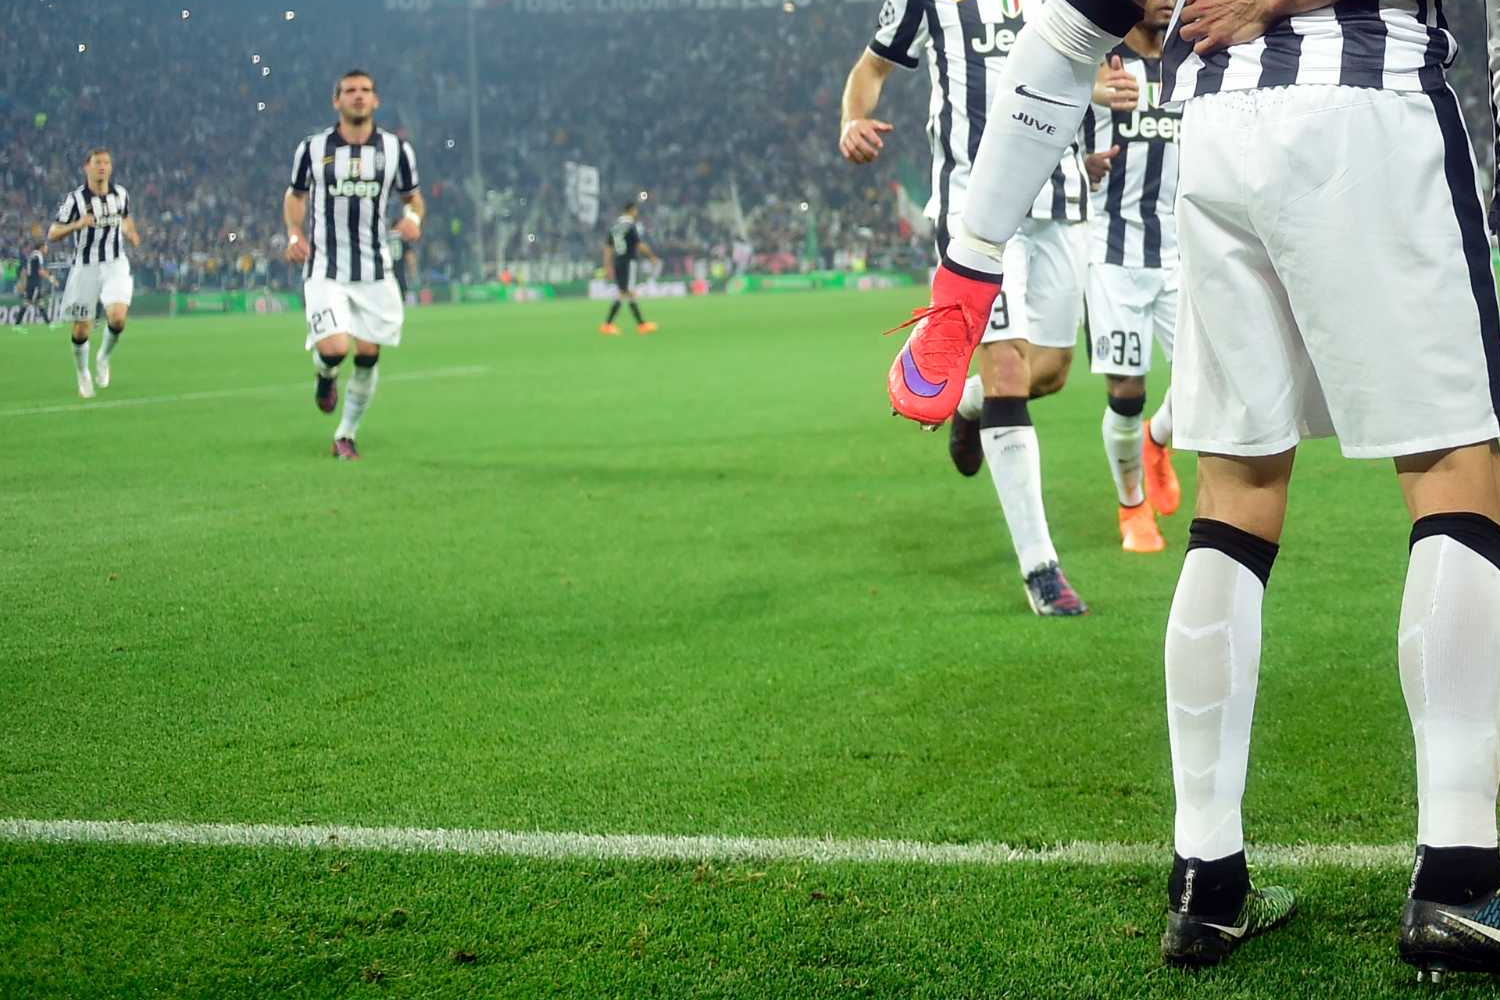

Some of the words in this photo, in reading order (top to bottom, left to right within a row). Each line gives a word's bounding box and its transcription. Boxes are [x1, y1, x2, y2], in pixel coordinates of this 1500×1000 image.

[971, 22, 1015, 53] Je
[1012, 112, 1056, 135] JUVE
[328, 180, 380, 198] Jeep
[311, 308, 338, 334] 27
[1111, 330, 1141, 367] 33
